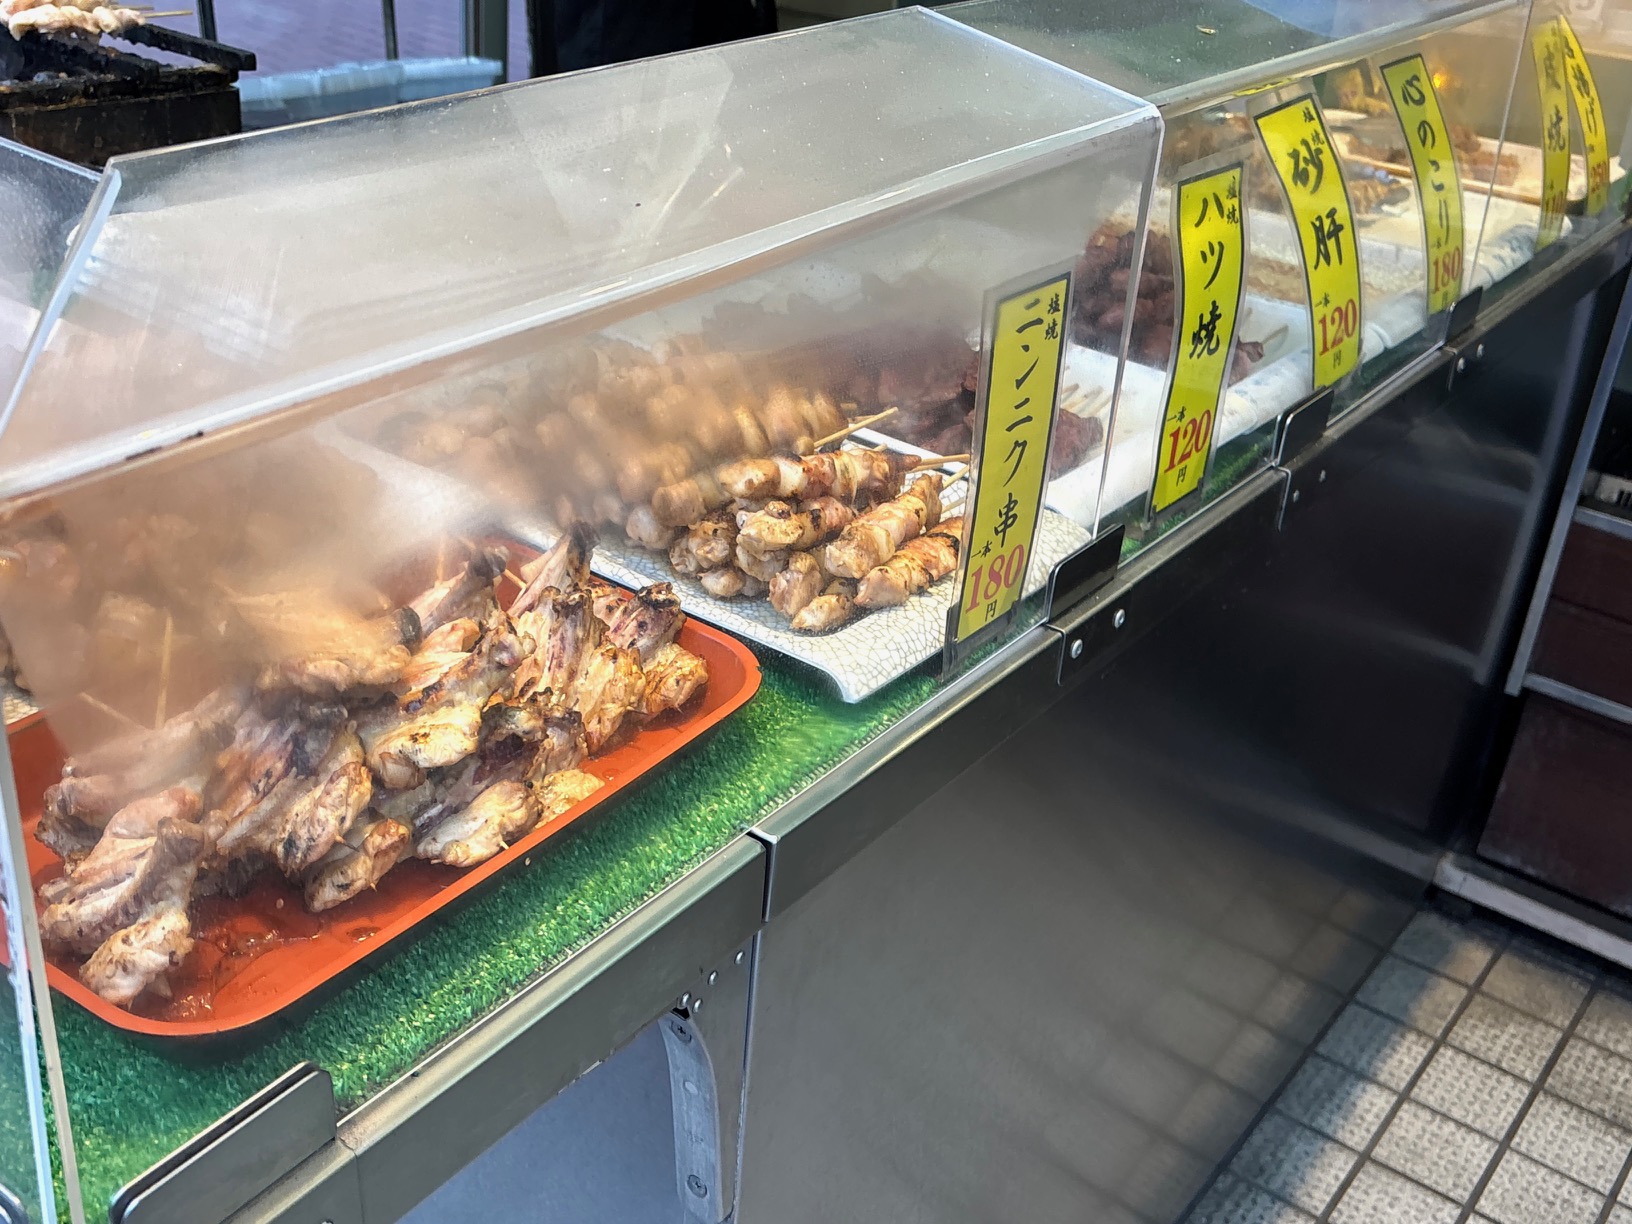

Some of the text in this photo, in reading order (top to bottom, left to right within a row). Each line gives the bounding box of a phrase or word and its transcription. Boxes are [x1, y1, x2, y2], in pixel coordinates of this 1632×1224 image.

[1401, 73, 1450, 246] 心のこり
[1287, 138, 1344, 271] 砂肝
[1189, 191, 1225, 360] ハツ焼
[1432, 248, 1462, 293] 180
[1044, 292, 1062, 340] 塩焼
[1318, 298, 1358, 357] 120
[994, 298, 1044, 549] ニンニク串
[1163, 408, 1212, 473] 120
[1175, 464, 1188, 487] 円
[965, 543, 1026, 615] 180
[984, 599, 998, 622] 円
